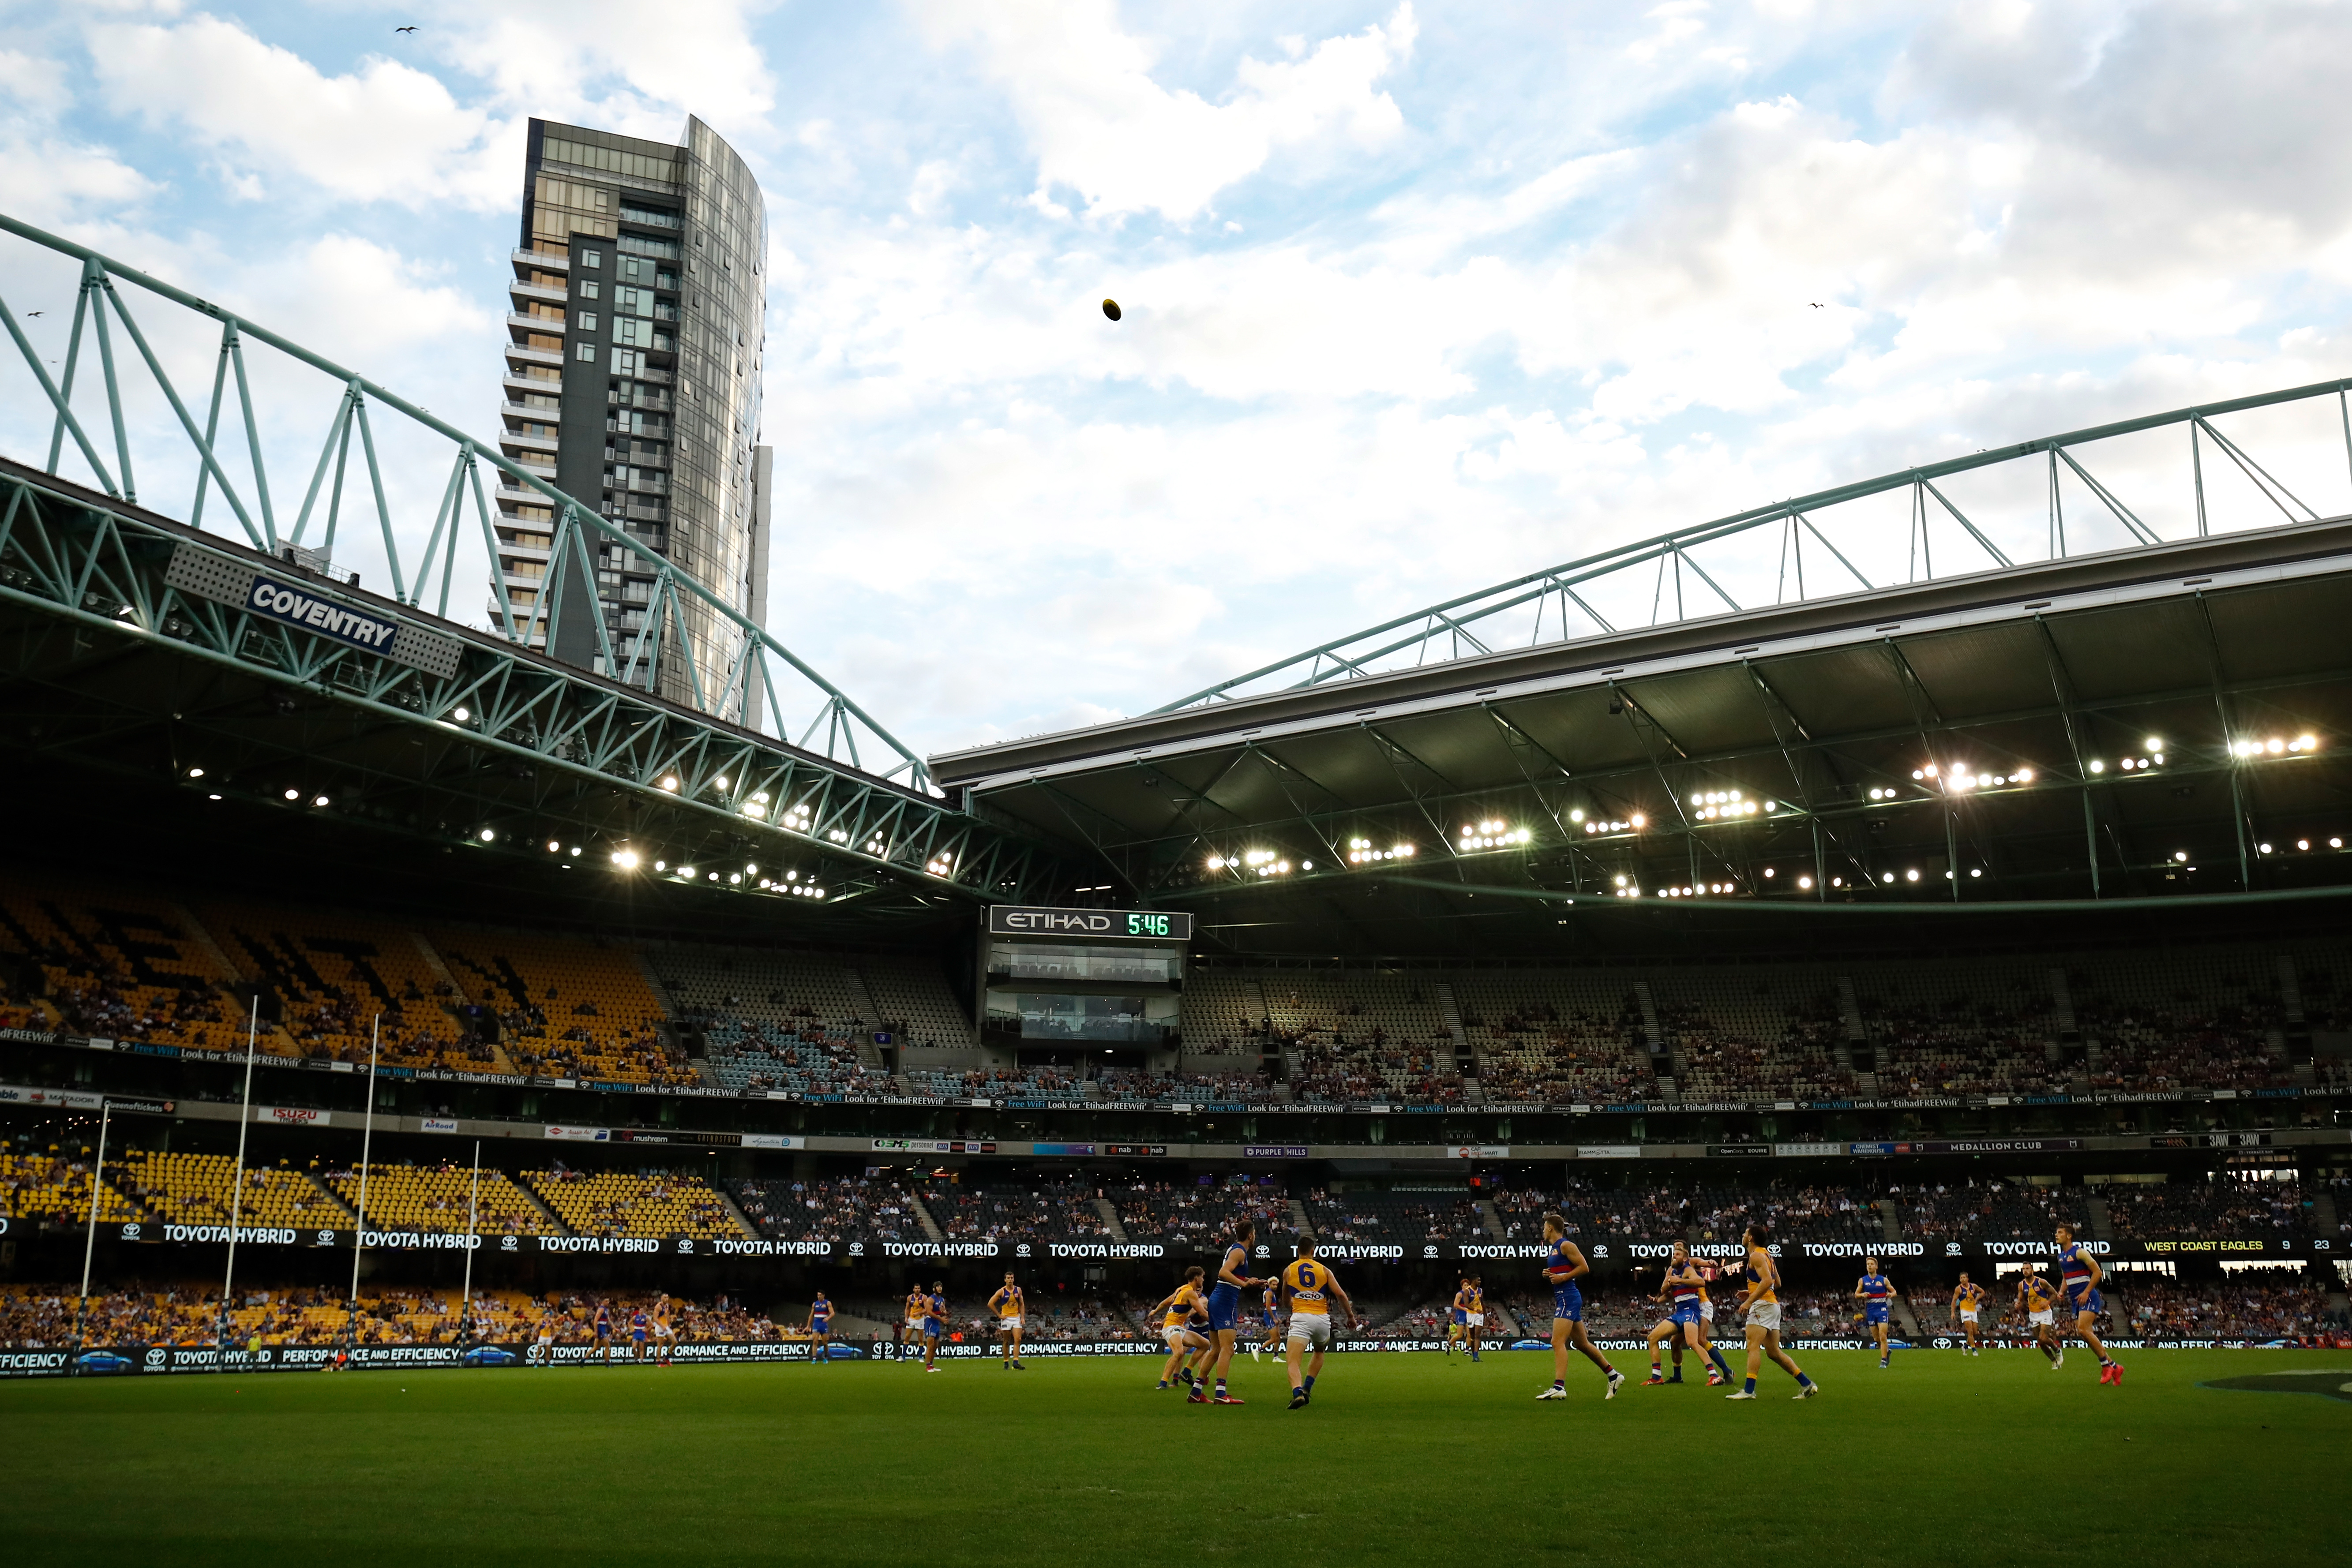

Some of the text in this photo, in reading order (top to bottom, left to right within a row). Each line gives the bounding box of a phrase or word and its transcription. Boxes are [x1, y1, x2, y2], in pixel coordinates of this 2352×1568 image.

[253, 584, 394, 647] COVENTRY
[1006, 913, 1110, 930] ETIHAD
[1128, 914, 1168, 935] 5:46
[845, 1094, 864, 1103] Look
[866, 1095, 878, 1103] for
[1891, 1098, 1959, 1107] 'EtihadFREEWifi'
[1083, 1102, 1147, 1110] 'EtihadFREEWifi'
[1683, 1103, 1748, 1111] 'EtihadFREEWifi'
[273, 1108, 317, 1119] ISUZU
[634, 1134, 668, 1143] mushroom
[2209, 1135, 2228, 1146] 3AW
[2240, 1134, 2259, 1145] 3AW
[1951, 1142, 2011, 1151] MEDALLION
[163, 1225, 296, 1244] TOYOTA HYBRID
[356, 1231, 481, 1249] TOYOTA HYBRID
[538, 1236, 659, 1253] TOYOTA HYBRID
[713, 1240, 831, 1255] TOYOTA HYBRID
[883, 1242, 998, 1257] TOYOTA HYBRID
[1049, 1244, 1164, 1257] TOYOTA HYBRID
[1629, 1244, 1745, 1257] TOYOT HYBRID
[1803, 1242, 1924, 1257] TOYOTA HYBRID
[1984, 1242, 2047, 1255] TOYOTA
[2144, 1240, 2329, 1252] WEST COAST EAGLES 9 23
[1290, 1245, 1403, 1257] TYOTA HYBRID
[1459, 1245, 1516, 1257] TOYOTA
[1298, 1263, 1315, 1287] 6
[730, 1346, 748, 1355] AND
[750, 1344, 810, 1355] EFFICIENCY
[941, 1345, 981, 1356] HYBRID
[990, 1343, 1073, 1355] PEFORMANCE
[1095, 1343, 1158, 1353] EFFICIENCY
[1594, 1340, 1637, 1350] TOYOTA
[1797, 1340, 1863, 1350] EFFICIENCY
[371, 1350, 389, 1360] AND
[391, 1347, 460, 1361] EFFICIENCY
